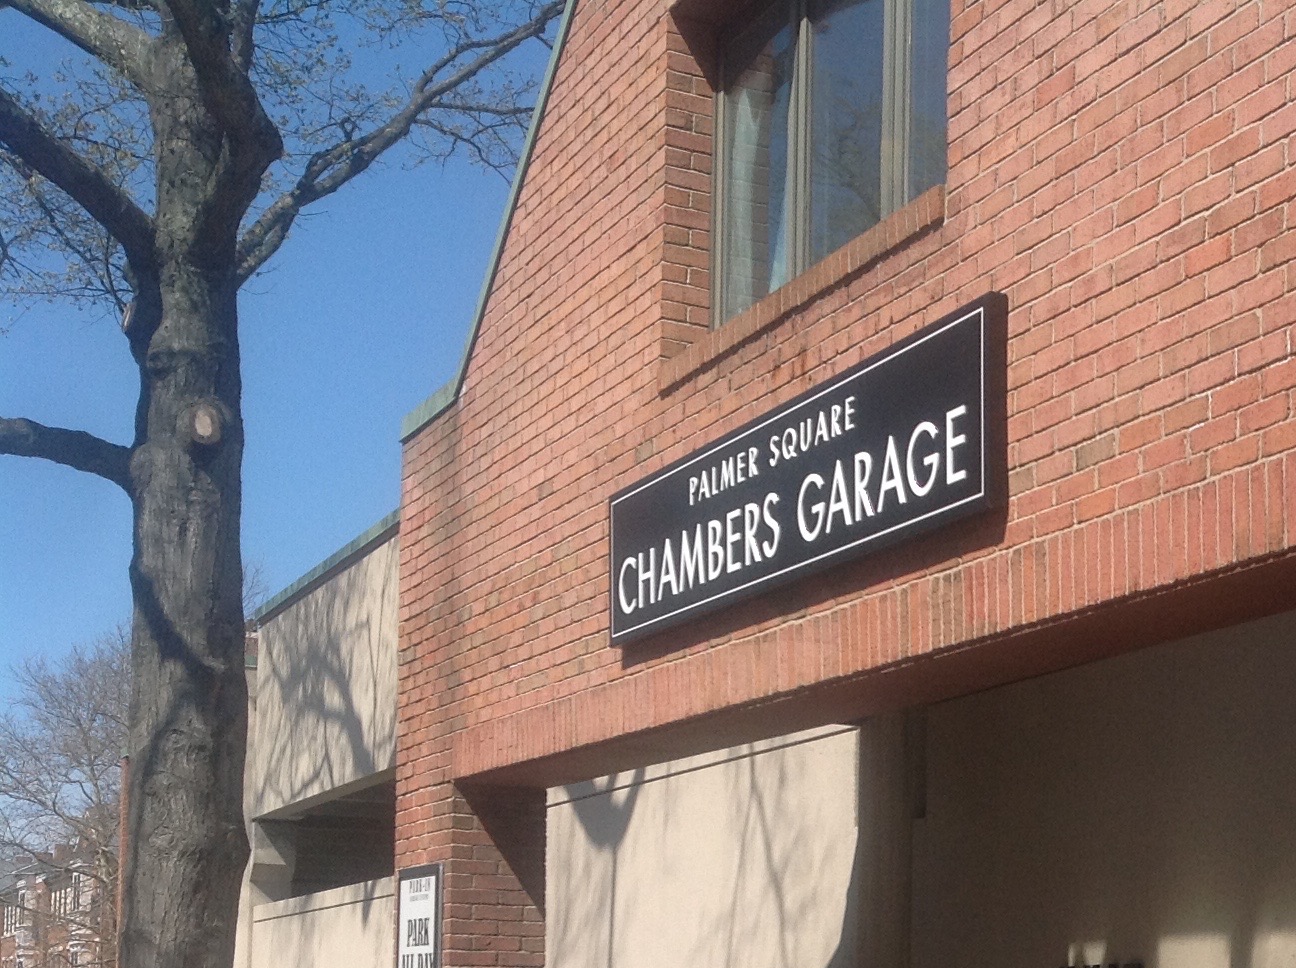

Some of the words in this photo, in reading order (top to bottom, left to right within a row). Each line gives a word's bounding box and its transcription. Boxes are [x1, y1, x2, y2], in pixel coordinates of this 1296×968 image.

[689, 447, 758, 505] PALMER
[769, 396, 855, 467] SQUARE
[619, 492, 780, 614] CHAMBERS
[798, 405, 967, 541] GARAGE
[407, 917, 429, 947] PARK
